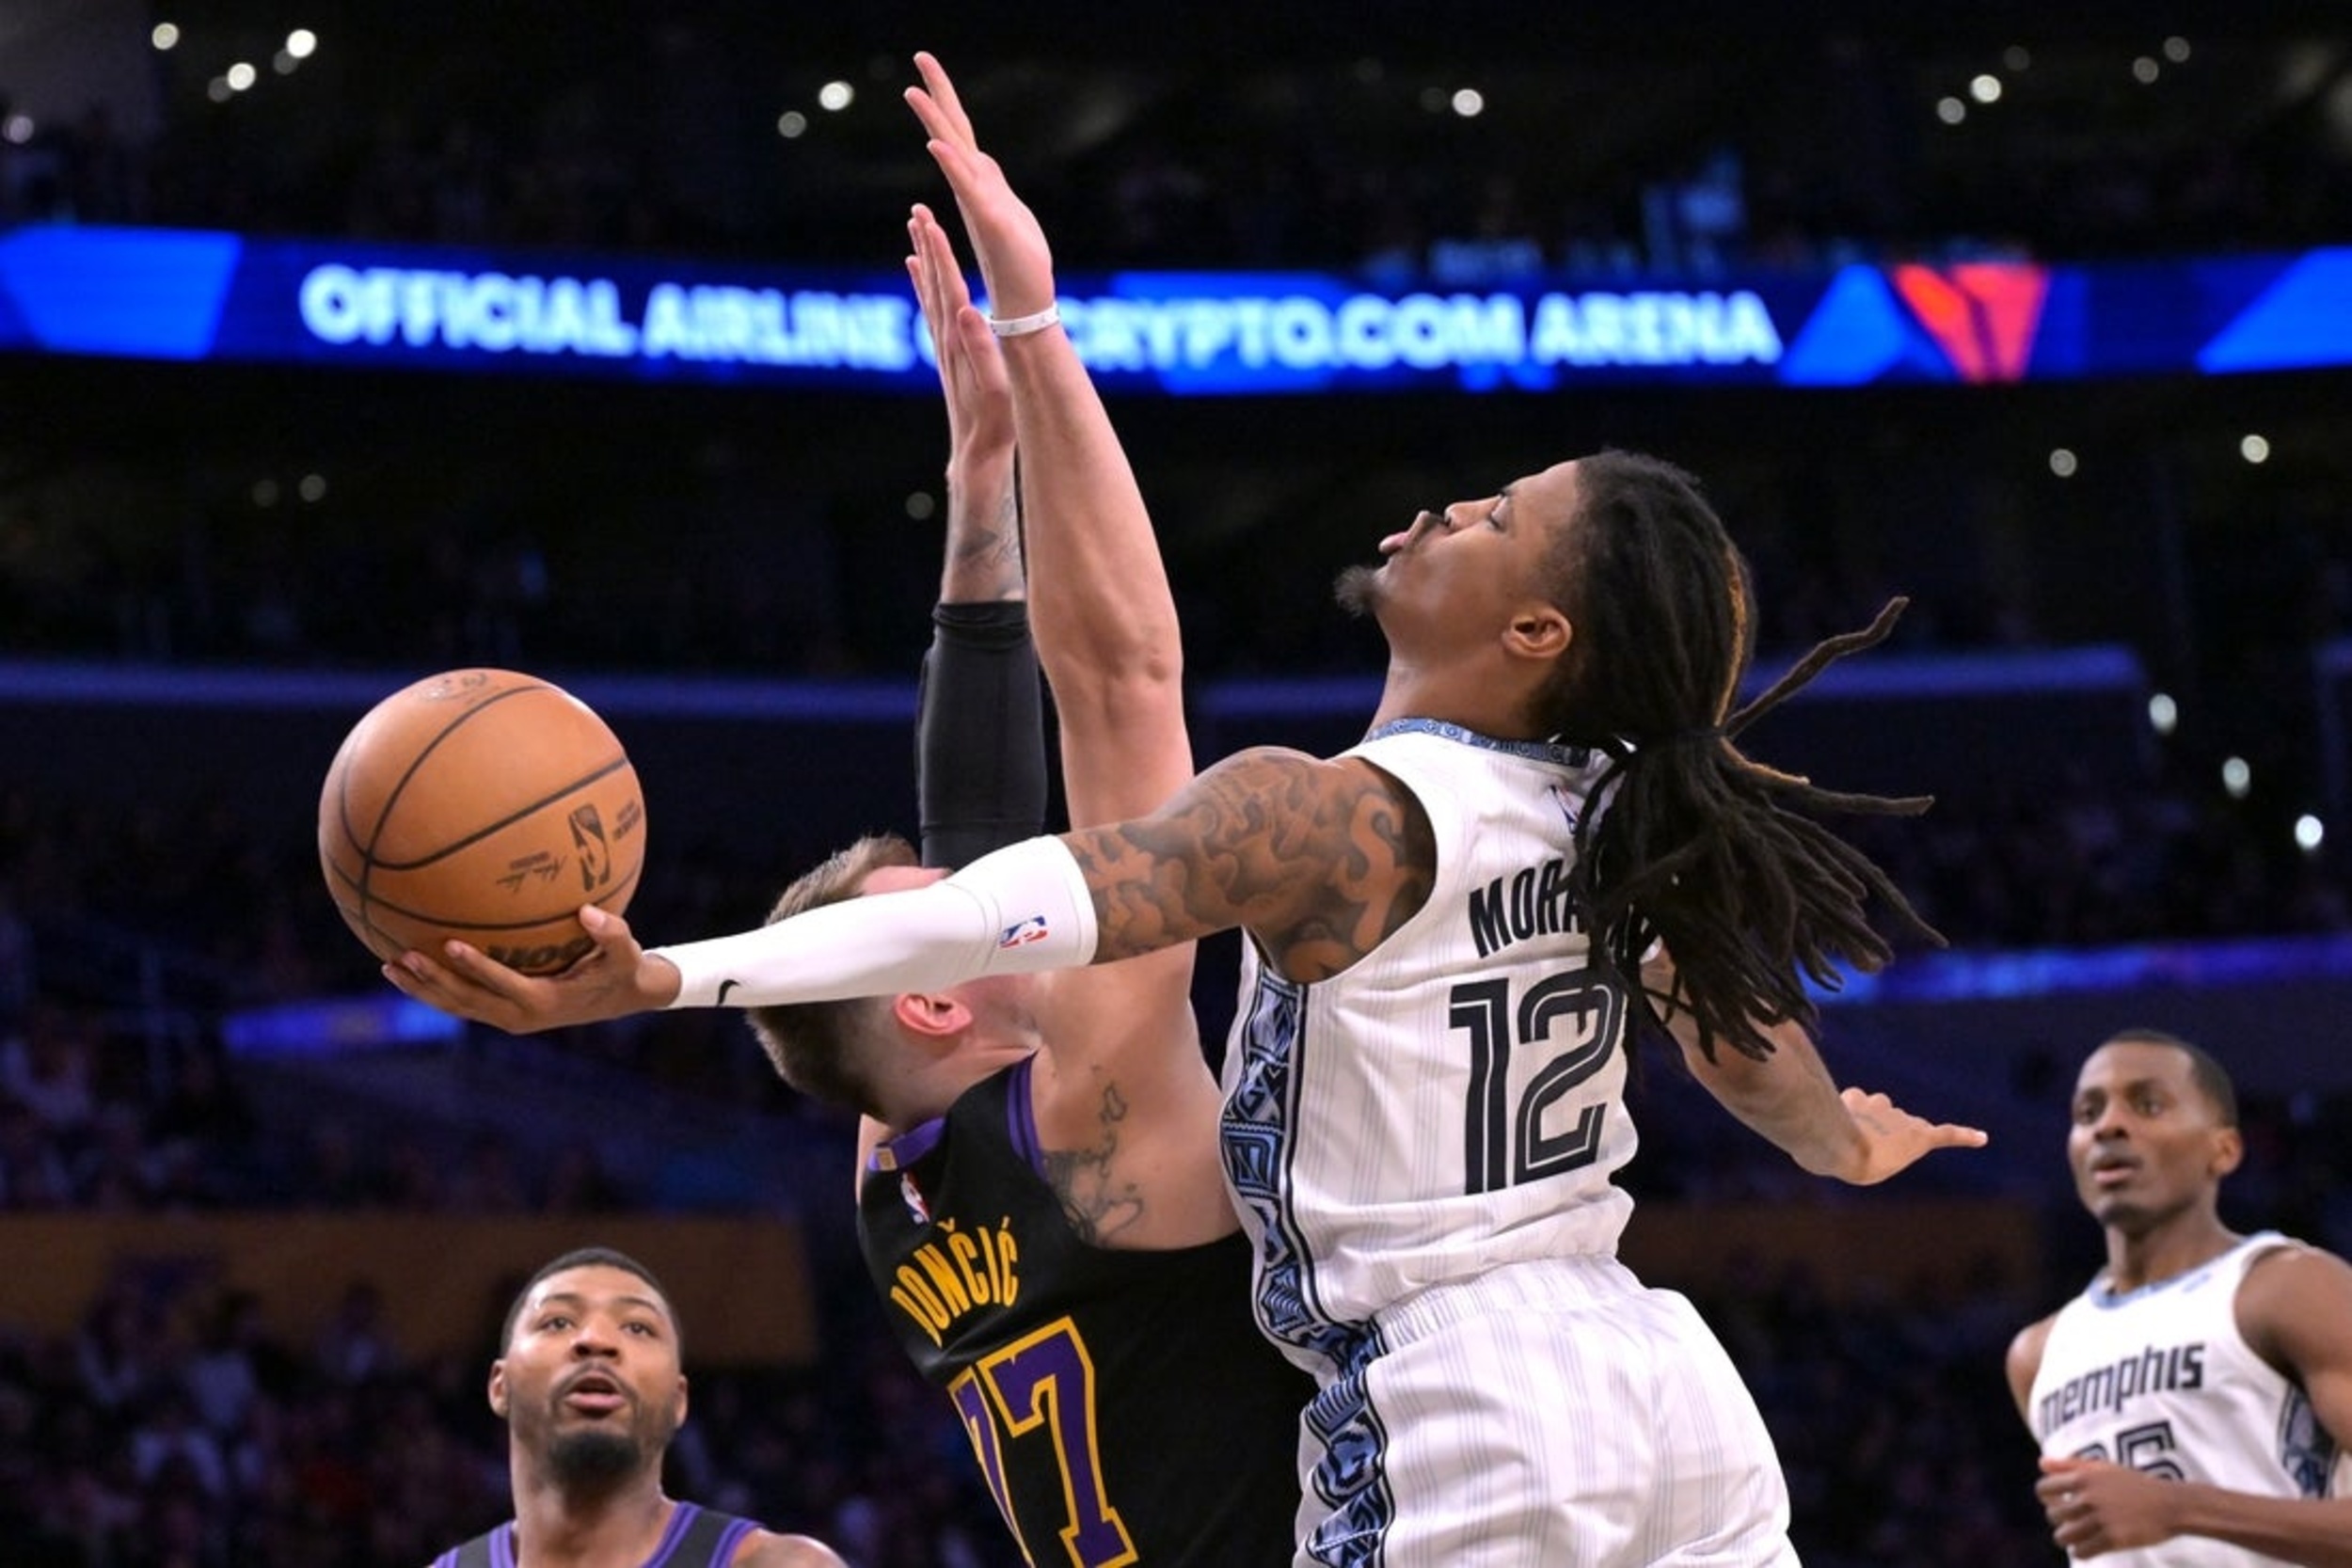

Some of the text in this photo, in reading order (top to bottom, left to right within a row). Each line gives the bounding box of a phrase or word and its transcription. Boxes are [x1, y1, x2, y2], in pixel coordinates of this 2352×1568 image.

[300, 264, 636, 356] OFFICIAL
[642, 283, 914, 371] AIRLINE
[1531, 292, 1782, 364] ARENA
[1469, 859, 1590, 958] MORA
[1449, 967, 1628, 1196] 12
[891, 1216, 1020, 1347] DONČIĆ
